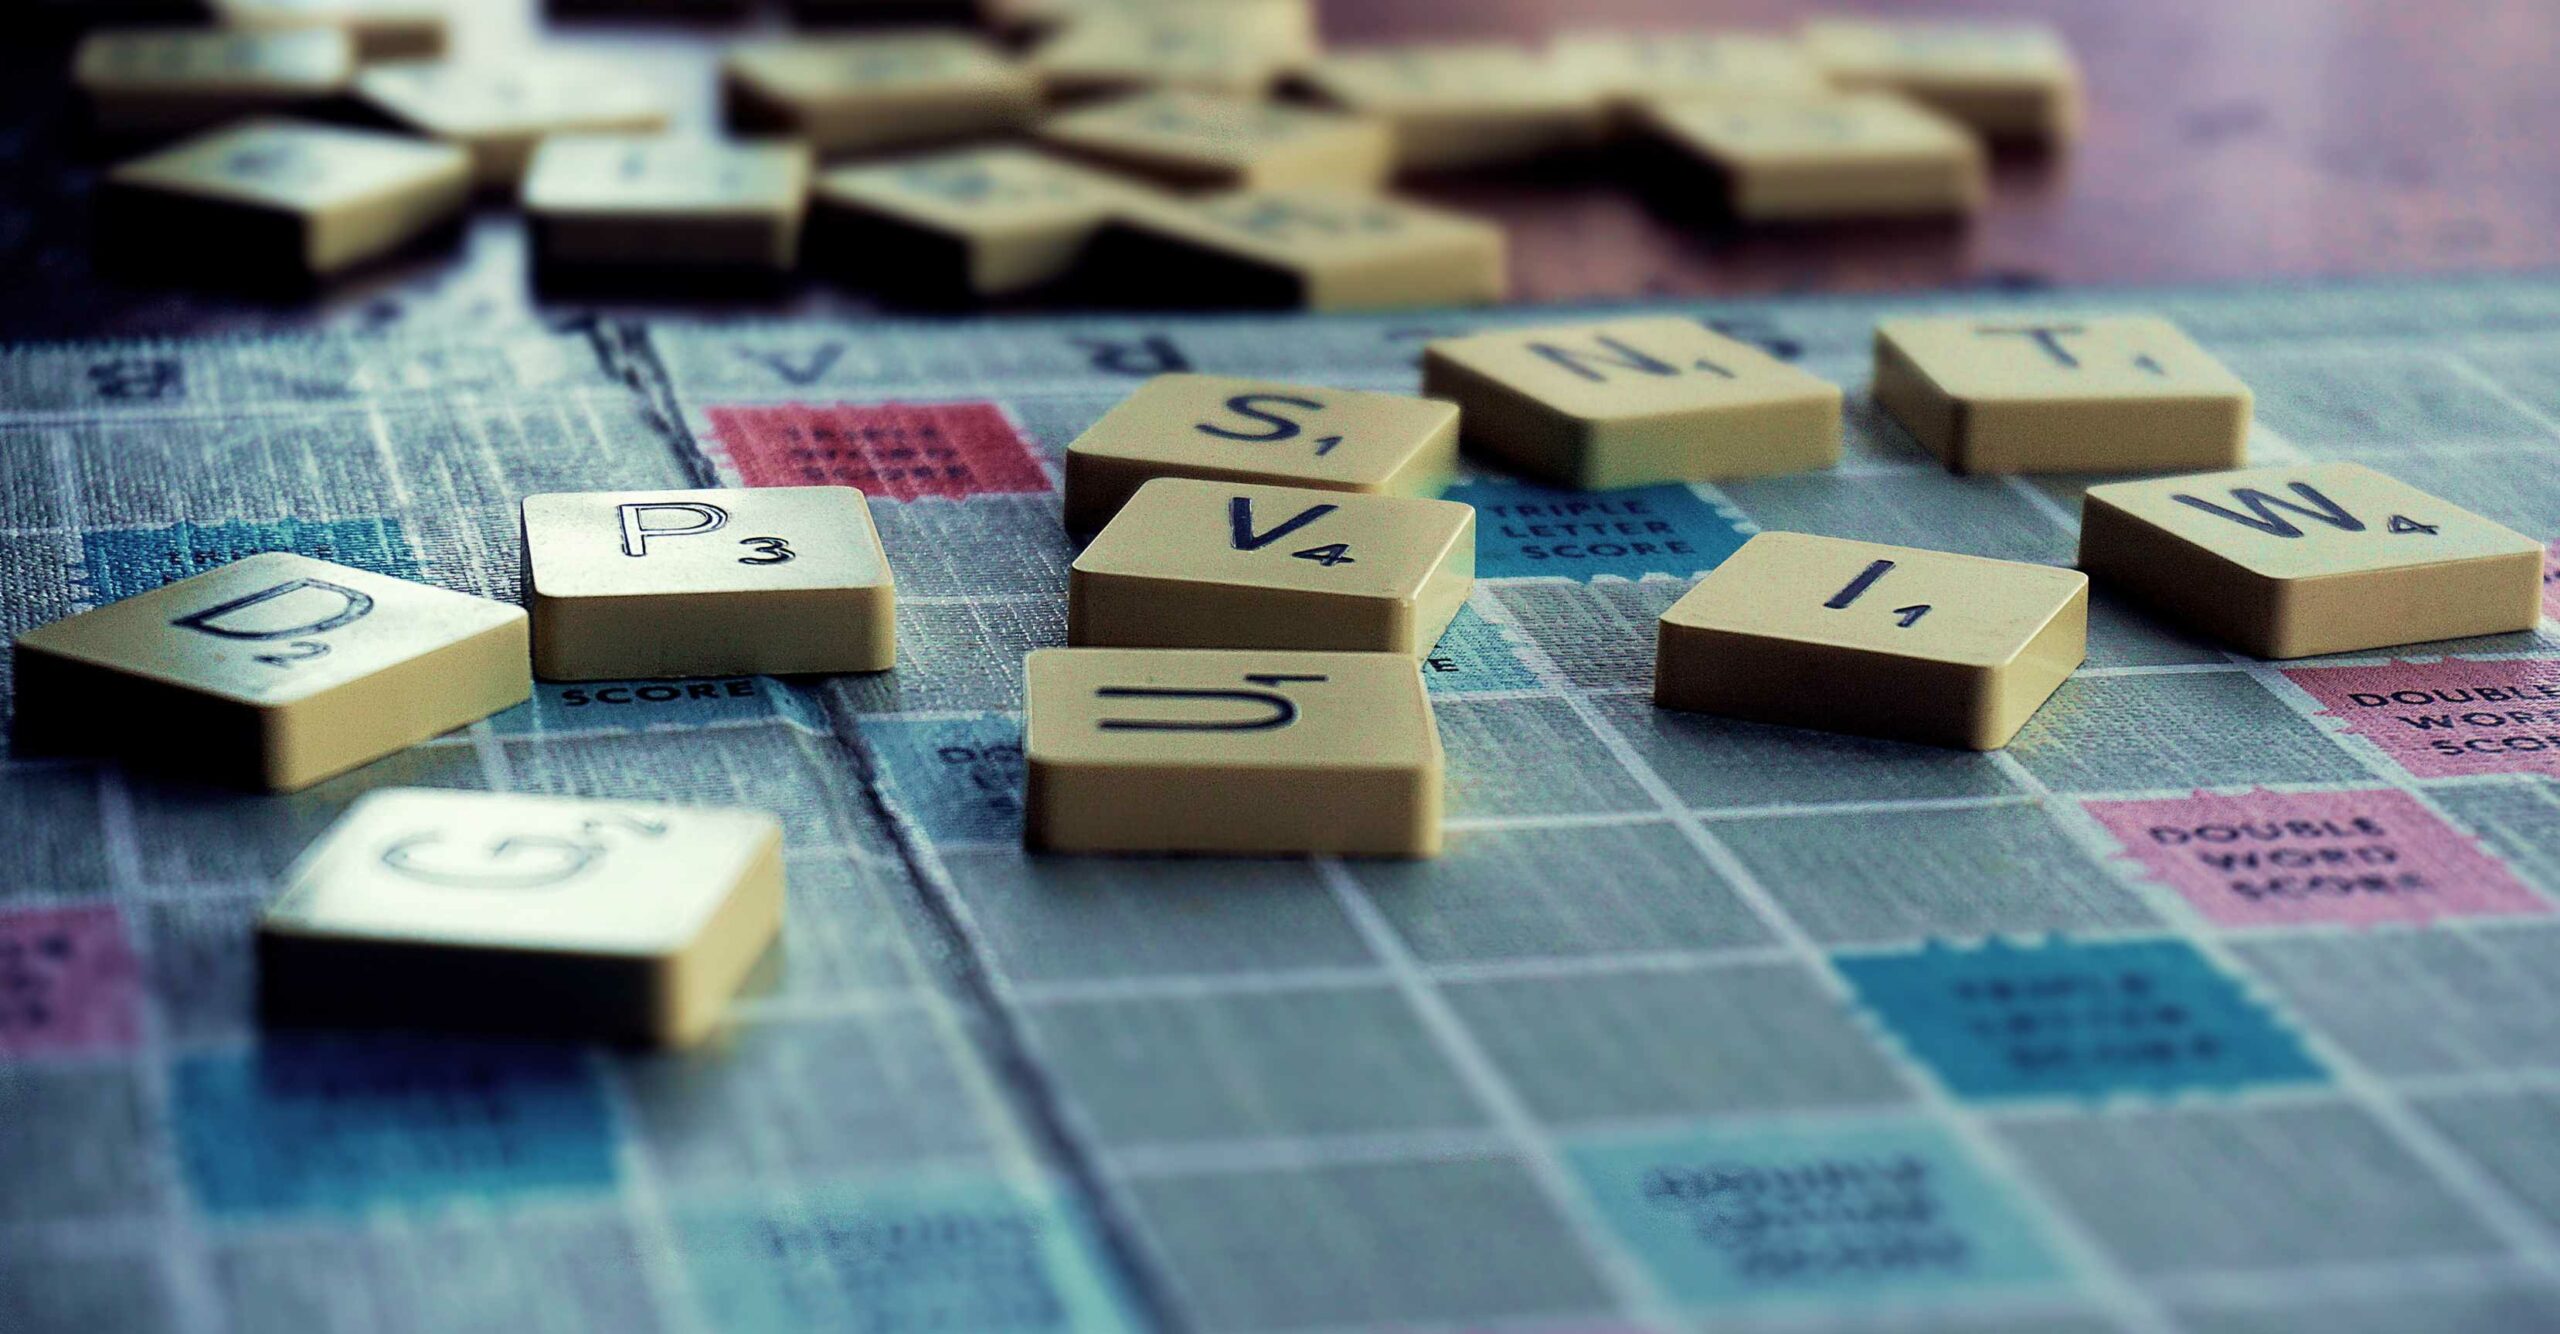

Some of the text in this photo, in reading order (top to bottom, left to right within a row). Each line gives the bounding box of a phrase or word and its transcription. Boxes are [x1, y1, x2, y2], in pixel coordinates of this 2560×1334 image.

[1525, 333, 1684, 383] N
[1972, 324, 2089, 369] T
[1194, 393, 1344, 458] S 1
[616, 500, 799, 567] P 3
[1228, 496, 1356, 567] V 4
[1484, 500, 1653, 519] TRIPLE
[1502, 520, 1677, 540] LETTER
[2171, 480, 2440, 539] W 4
[1520, 541, 1699, 561] SCORE
[168, 577, 376, 640] D
[1822, 558, 1933, 629] I 1
[560, 679, 757, 708] SCORE
[1095, 684, 1305, 734] U
[2148, 815, 2387, 845] DOUBLE
[378, 826, 609, 892] G
